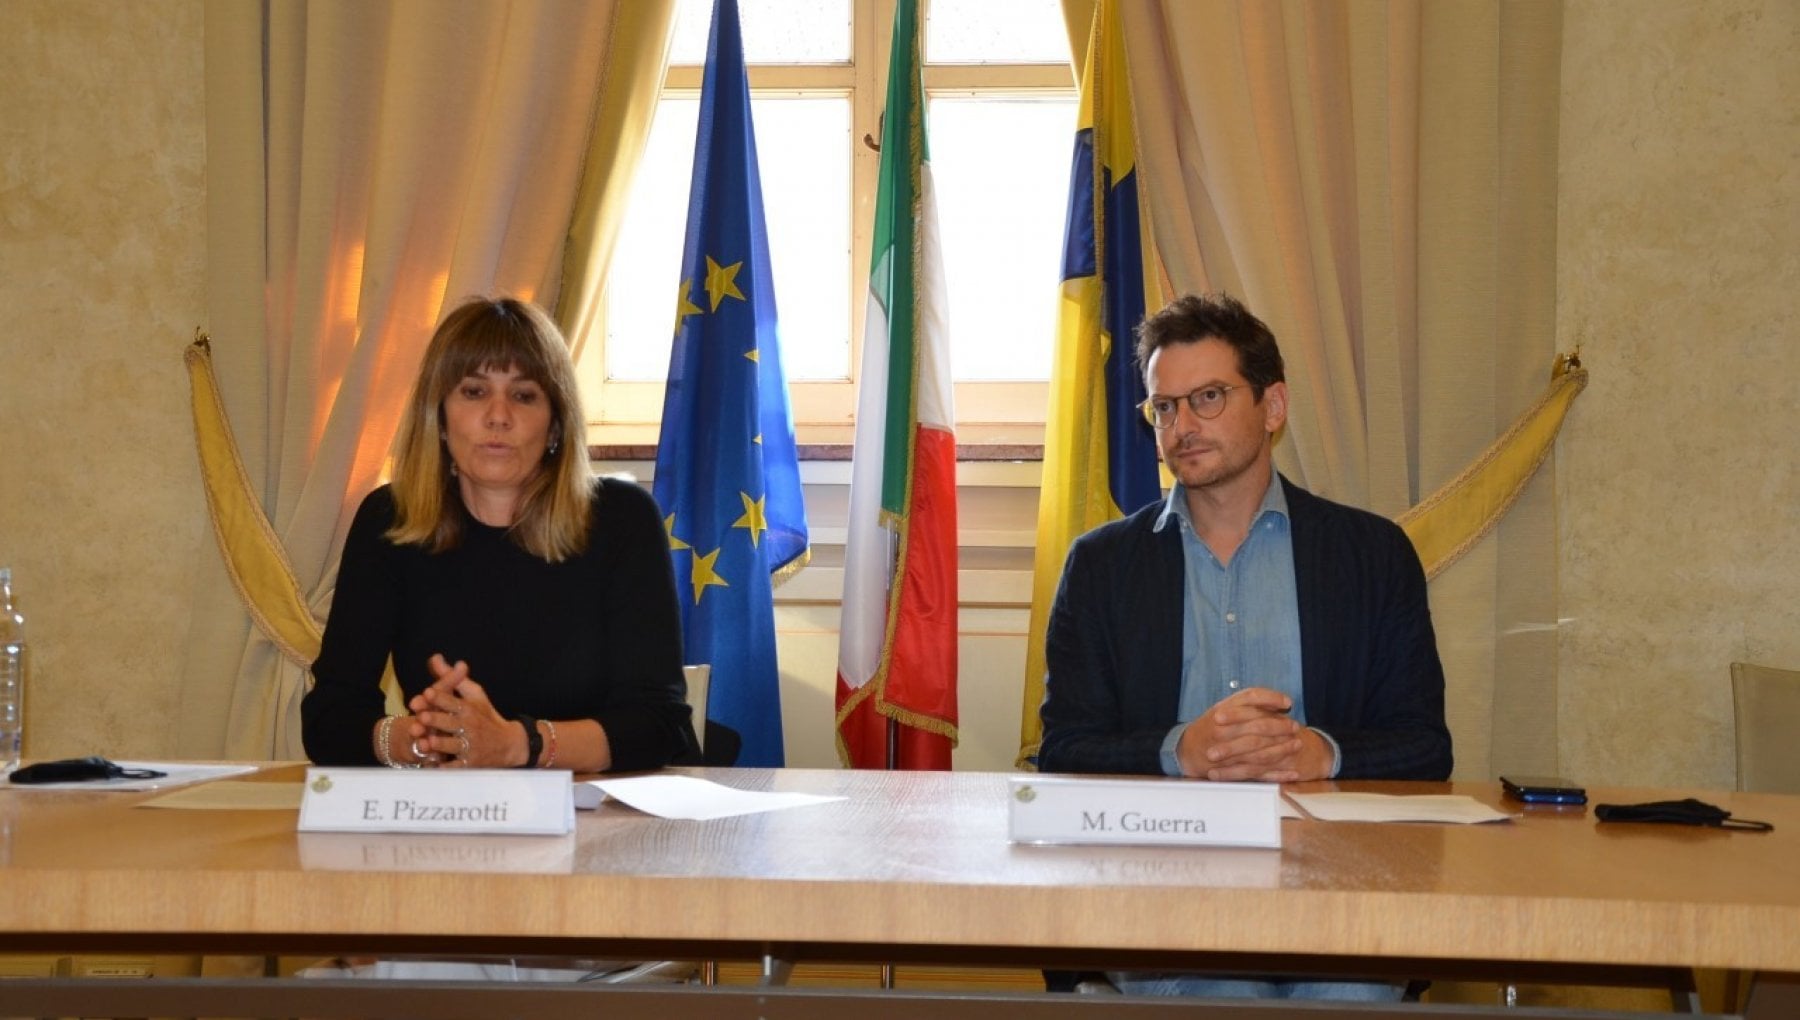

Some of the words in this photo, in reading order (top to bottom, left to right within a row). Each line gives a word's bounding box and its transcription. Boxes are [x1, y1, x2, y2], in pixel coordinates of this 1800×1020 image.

[362, 800, 384, 821] E.
[393, 800, 508, 822] Pizzarotti
[1081, 811, 1112, 831] M.
[1121, 811, 1207, 834] Guerra
